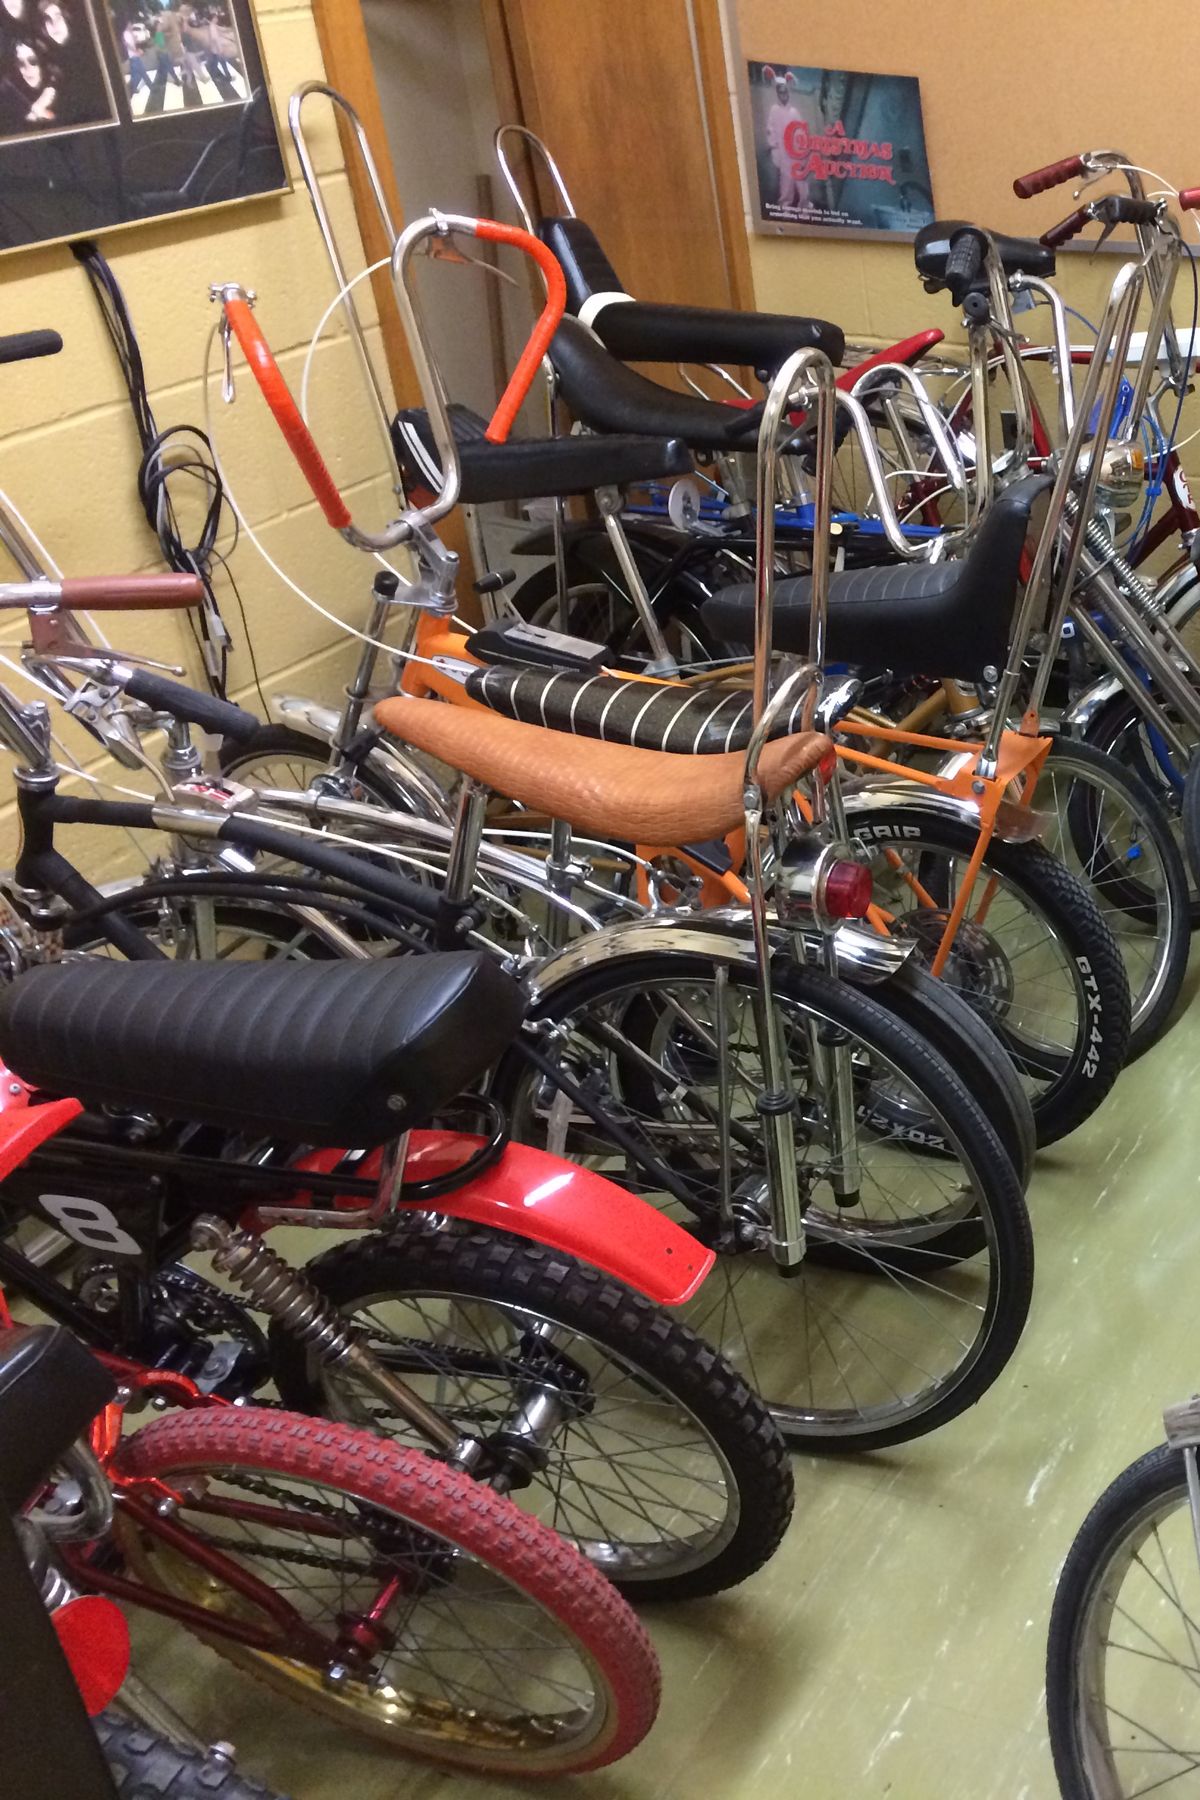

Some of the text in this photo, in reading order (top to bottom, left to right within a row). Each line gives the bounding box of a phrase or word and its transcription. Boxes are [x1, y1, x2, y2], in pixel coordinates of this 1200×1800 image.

[825, 120, 846, 137] A
[853, 825, 921, 840] GRIP
[1075, 956, 1104, 1080] GTX-442
[38, 1193, 143, 1256] 8
